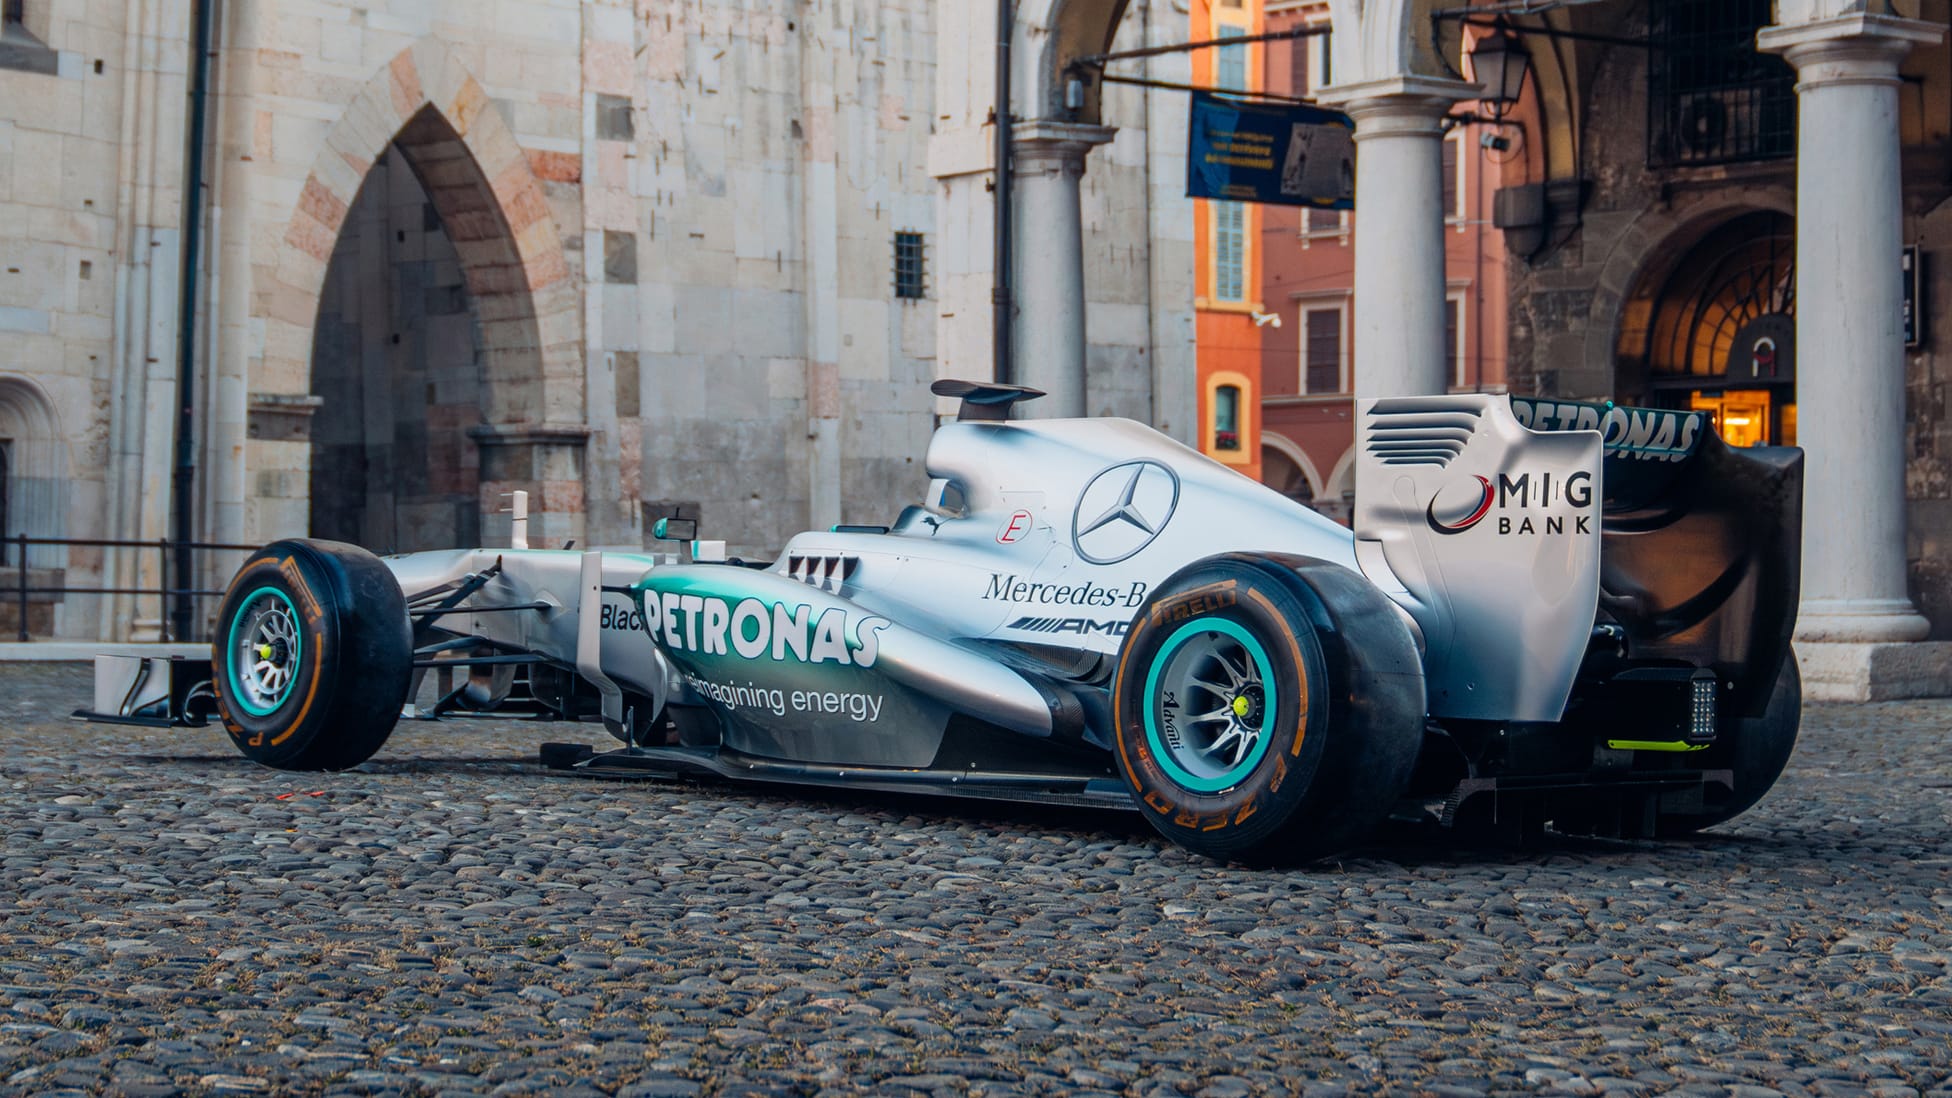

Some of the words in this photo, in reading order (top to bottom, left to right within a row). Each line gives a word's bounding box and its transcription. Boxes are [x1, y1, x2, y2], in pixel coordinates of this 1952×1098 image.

[1002, 515, 1026, 541] E
[1499, 516, 1591, 535] BANK
[981, 573, 1148, 608] Mercedes-B
[600, 603, 644, 631] Blac
[644, 588, 892, 668] PETRONAS
[791, 690, 883, 722] energy
[1163, 690, 1185, 750] Advanti
[1143, 789, 1258, 832] ZERO
